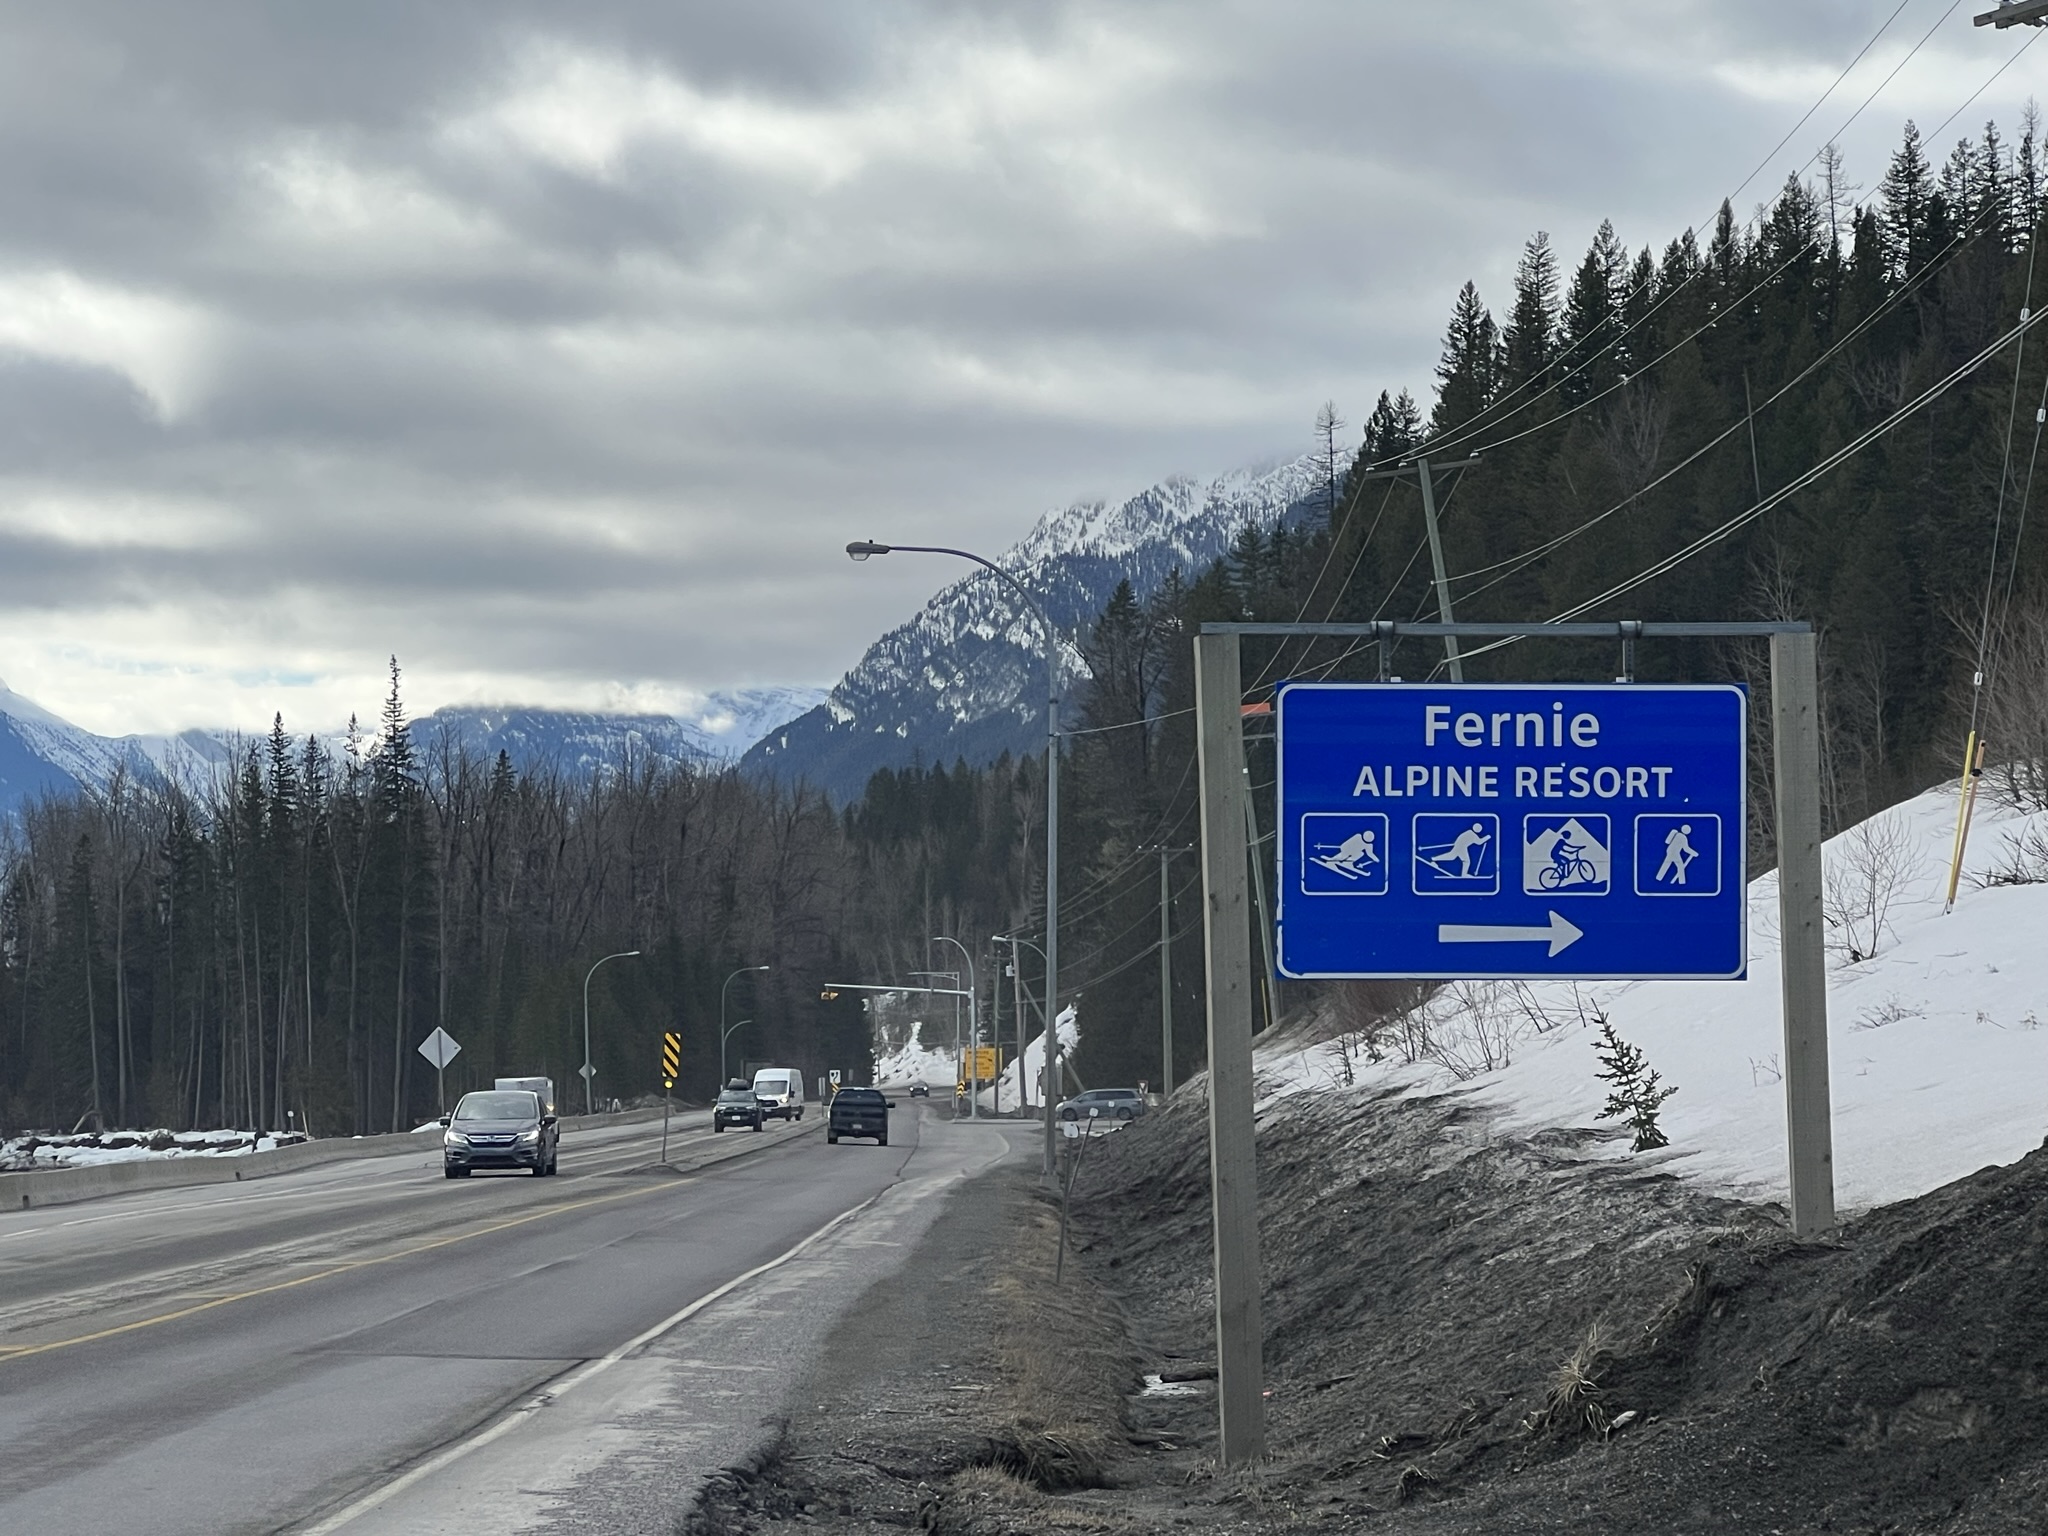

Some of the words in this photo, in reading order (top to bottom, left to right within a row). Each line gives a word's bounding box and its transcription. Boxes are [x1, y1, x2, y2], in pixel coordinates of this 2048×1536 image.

[1425, 702, 1600, 748] Fernie
[1353, 765, 1499, 798] ALPINE
[1515, 766, 1673, 798] RESORT
